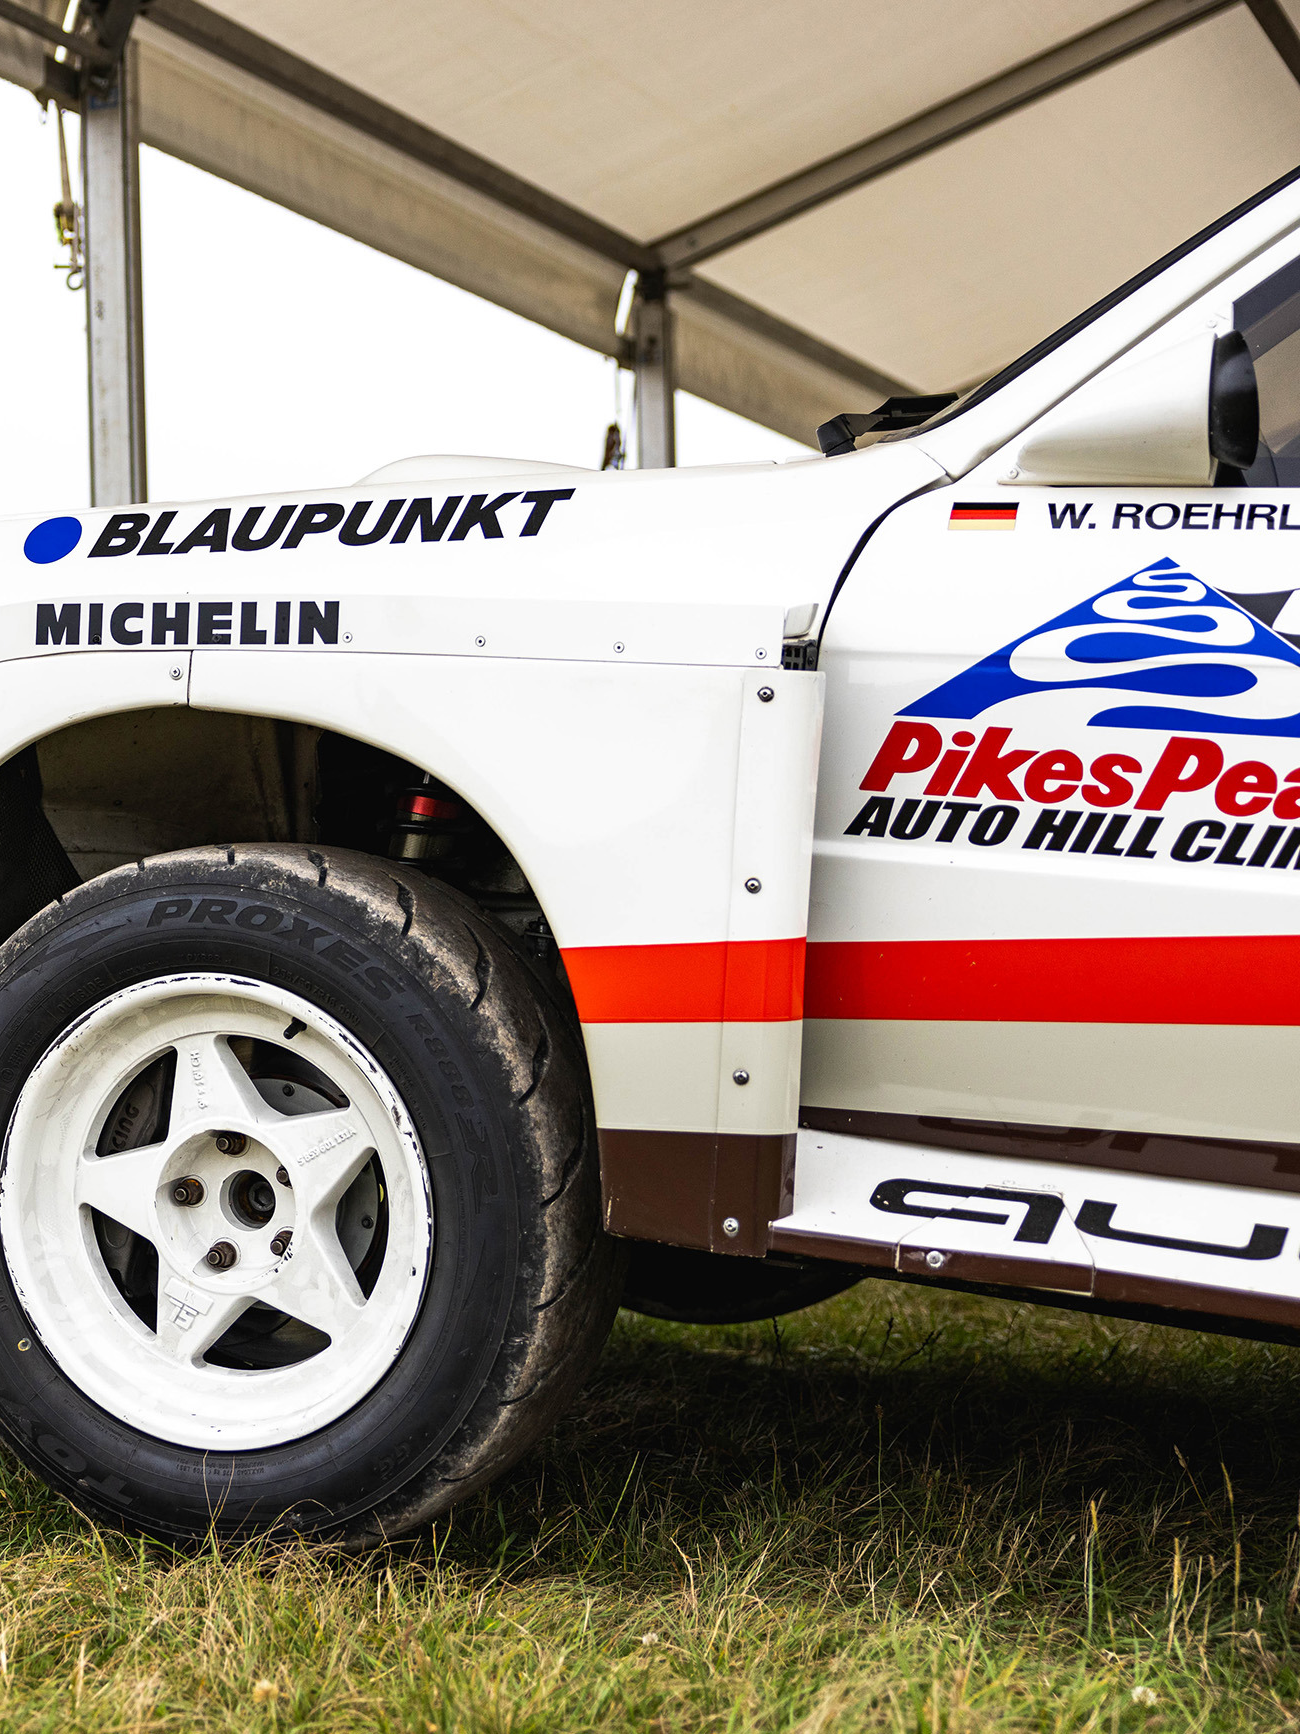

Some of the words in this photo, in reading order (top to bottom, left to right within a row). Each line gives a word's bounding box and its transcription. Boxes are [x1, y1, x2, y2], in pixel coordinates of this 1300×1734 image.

[87, 487, 576, 558] BLAUPUNKT
[1048, 502, 1096, 530] W.
[1111, 502, 1300, 530] ROEHRL
[35, 600, 340, 646] MICHELIN
[842, 795, 1020, 847] AUTO
[1021, 808, 1165, 859] HILL
[147, 897, 405, 1004] PROXES
[56, 975, 105, 1015] OUTSIDE
[112, 1103, 139, 1151] CING
[869, 1177, 1300, 1261] qu
